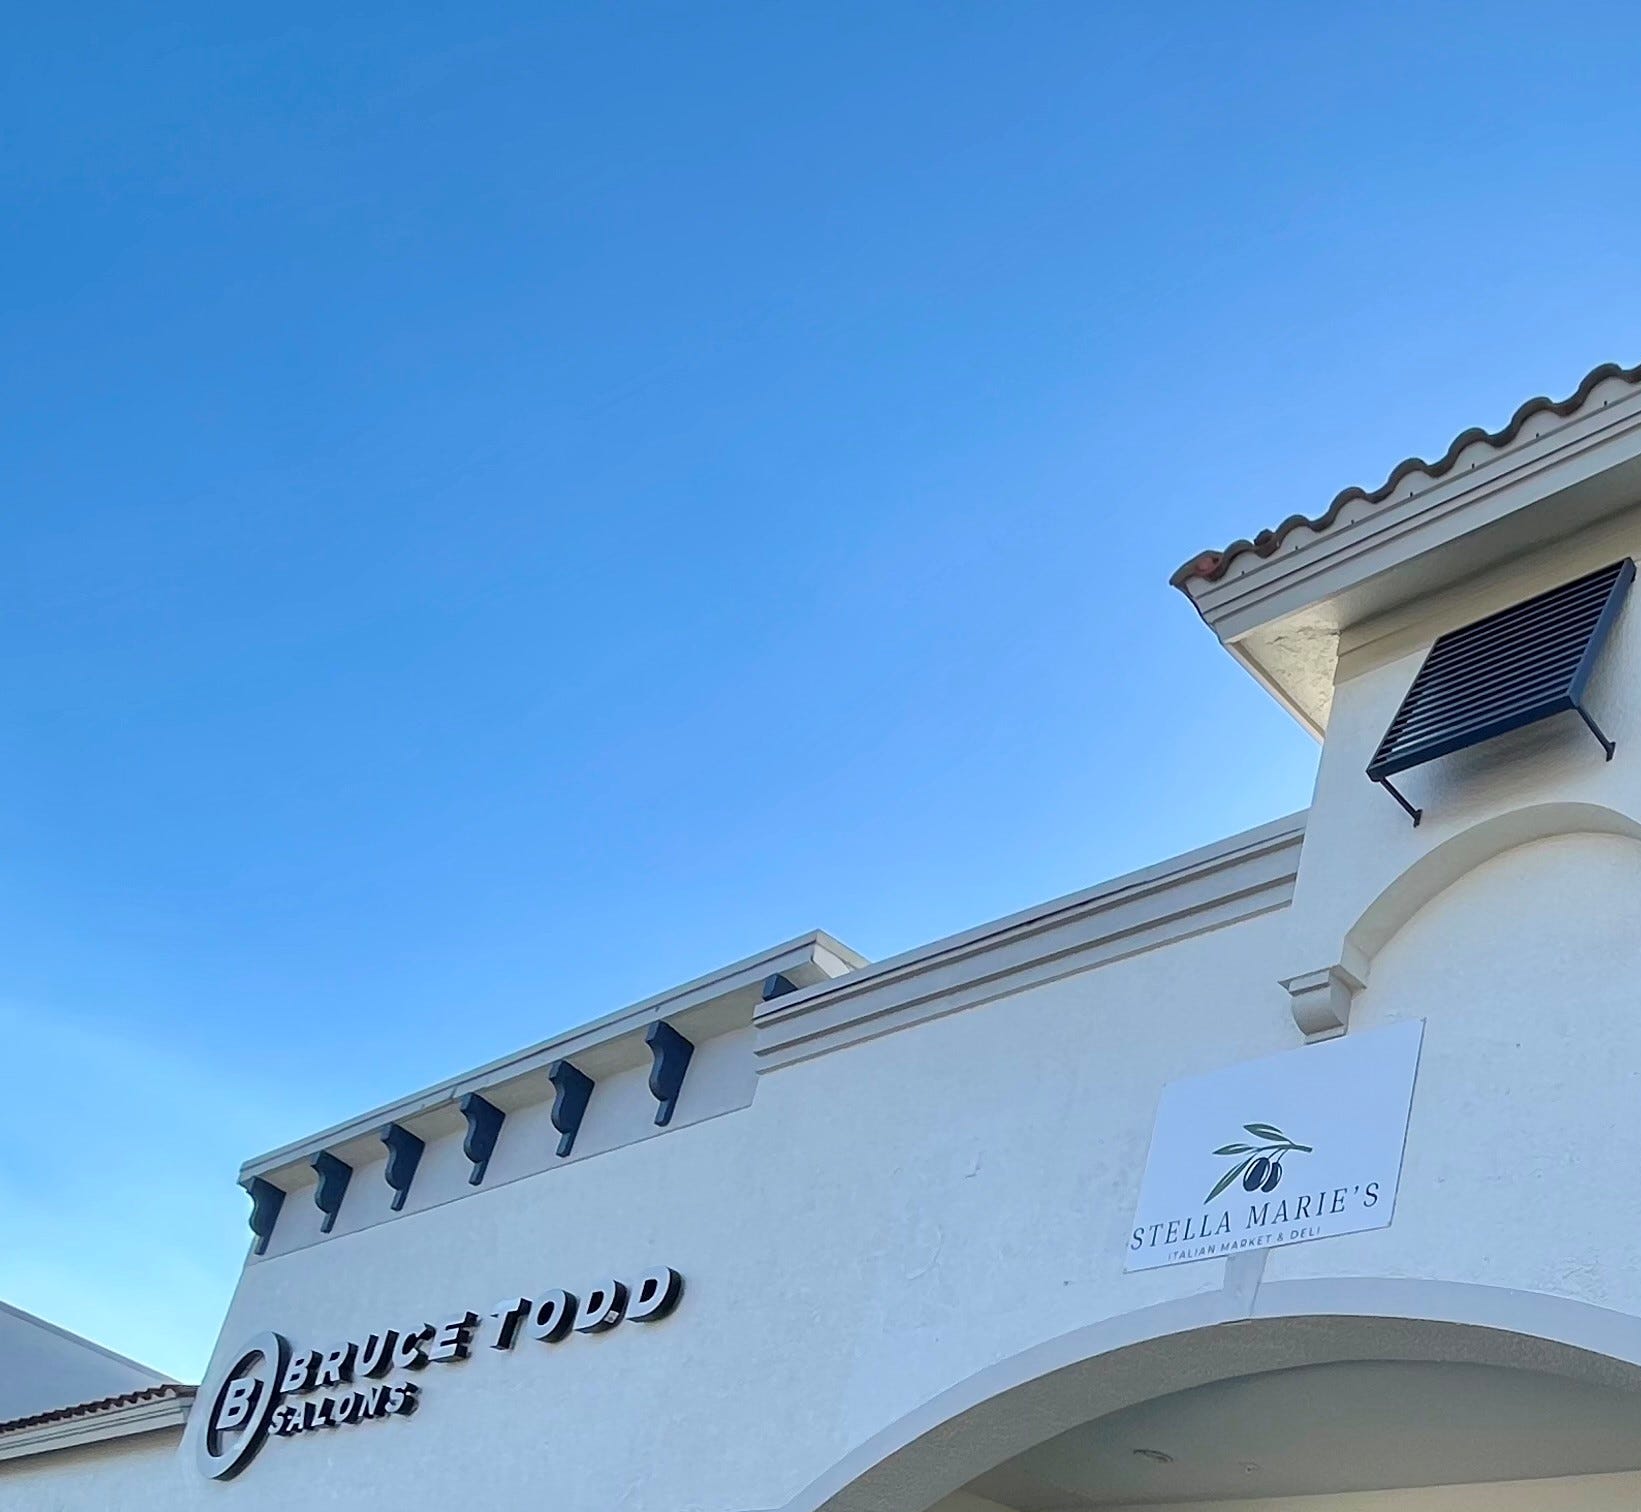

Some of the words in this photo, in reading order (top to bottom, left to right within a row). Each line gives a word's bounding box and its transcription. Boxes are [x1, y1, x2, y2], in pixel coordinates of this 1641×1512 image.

[1130, 1210, 1232, 1251] STELLA
[1244, 1181, 1380, 1230] MARIE'S
[1167, 1243, 1217, 1261] ITALIAN
[1220, 1234, 1273, 1252] MARKET
[1276, 1232, 1284, 1242] &
[1289, 1226, 1321, 1241] DELI
[280, 1310, 479, 1394] BRUCE
[490, 1265, 686, 1351] TODD
[267, 1381, 422, 1437] SALONS
